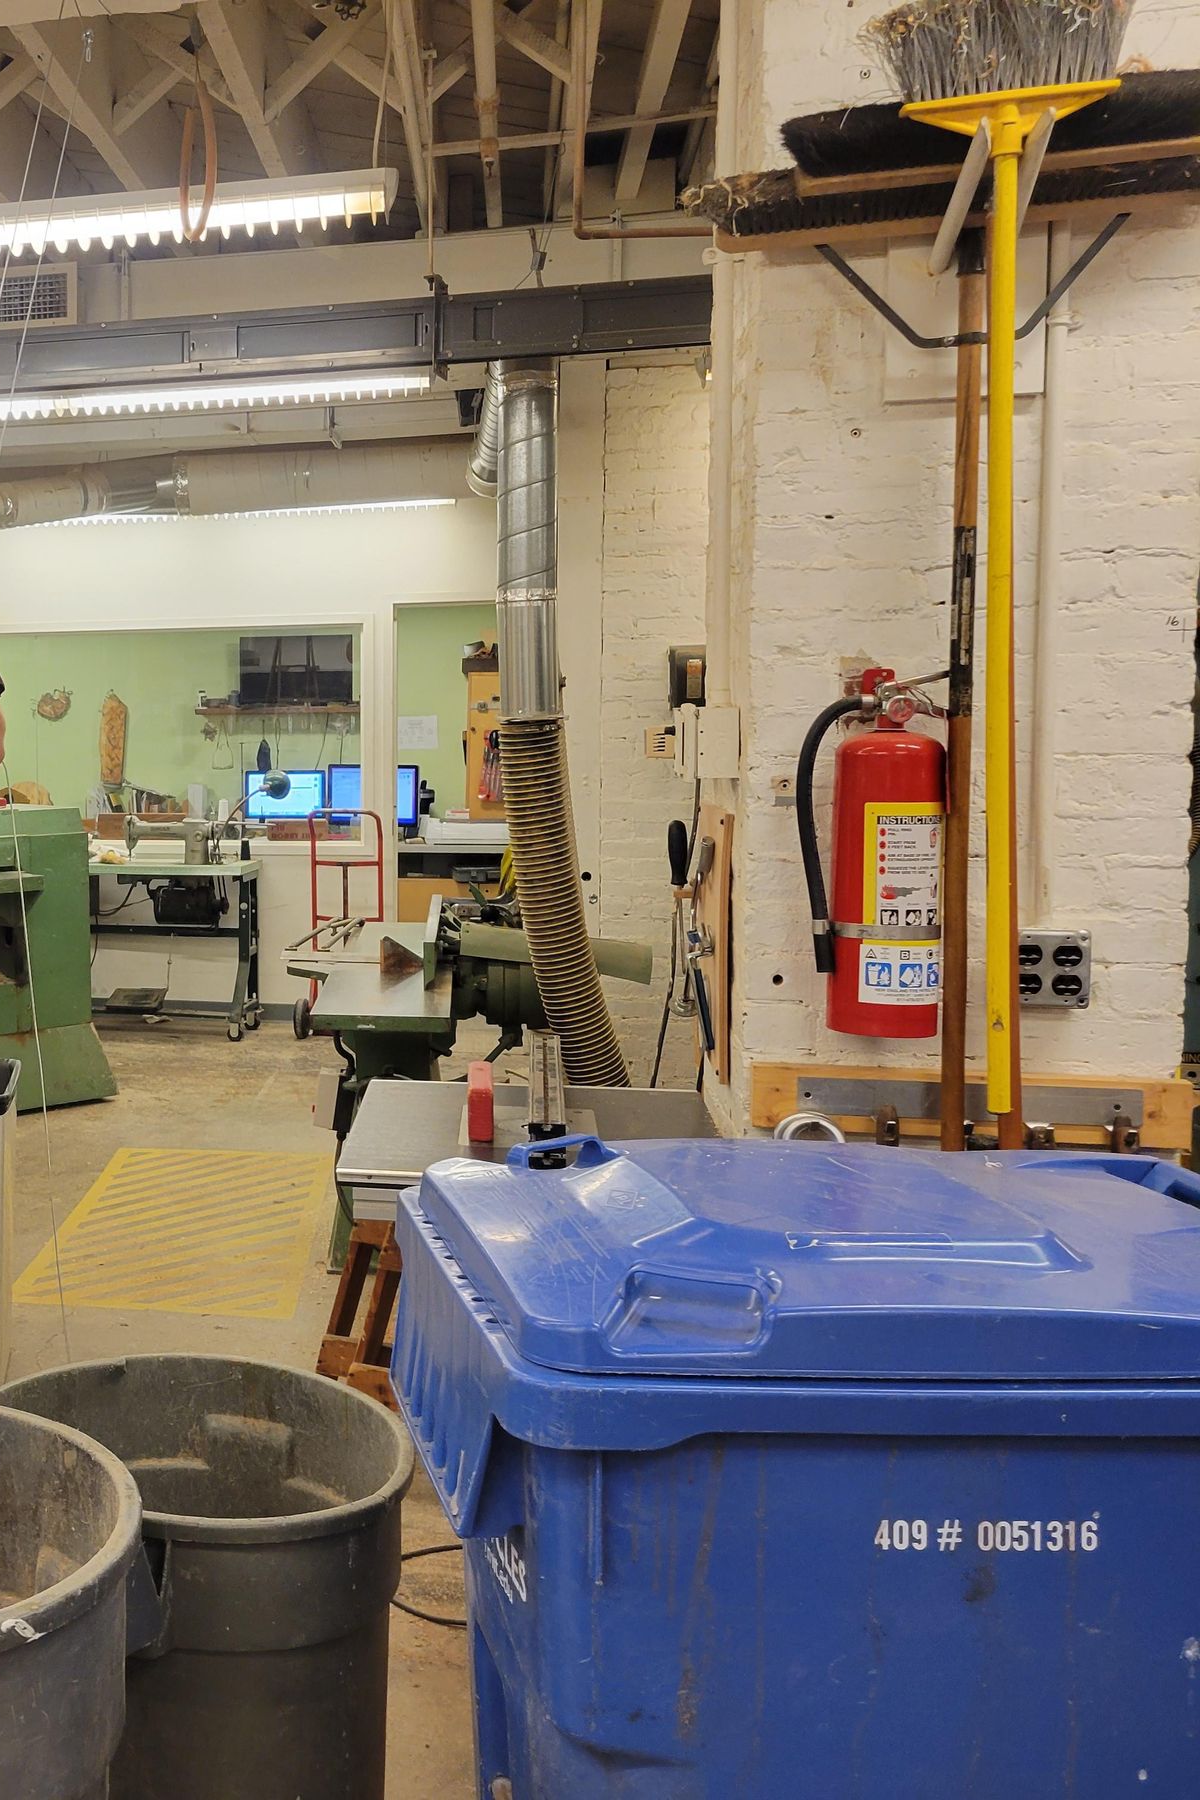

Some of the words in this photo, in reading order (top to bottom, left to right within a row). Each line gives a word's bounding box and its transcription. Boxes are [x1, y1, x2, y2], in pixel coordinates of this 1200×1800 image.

[1166, 616, 1180, 627] 16
[874, 1519, 928, 1550] 409
[937, 1519, 962, 1551] #
[977, 1520, 1098, 1551] 0051316
